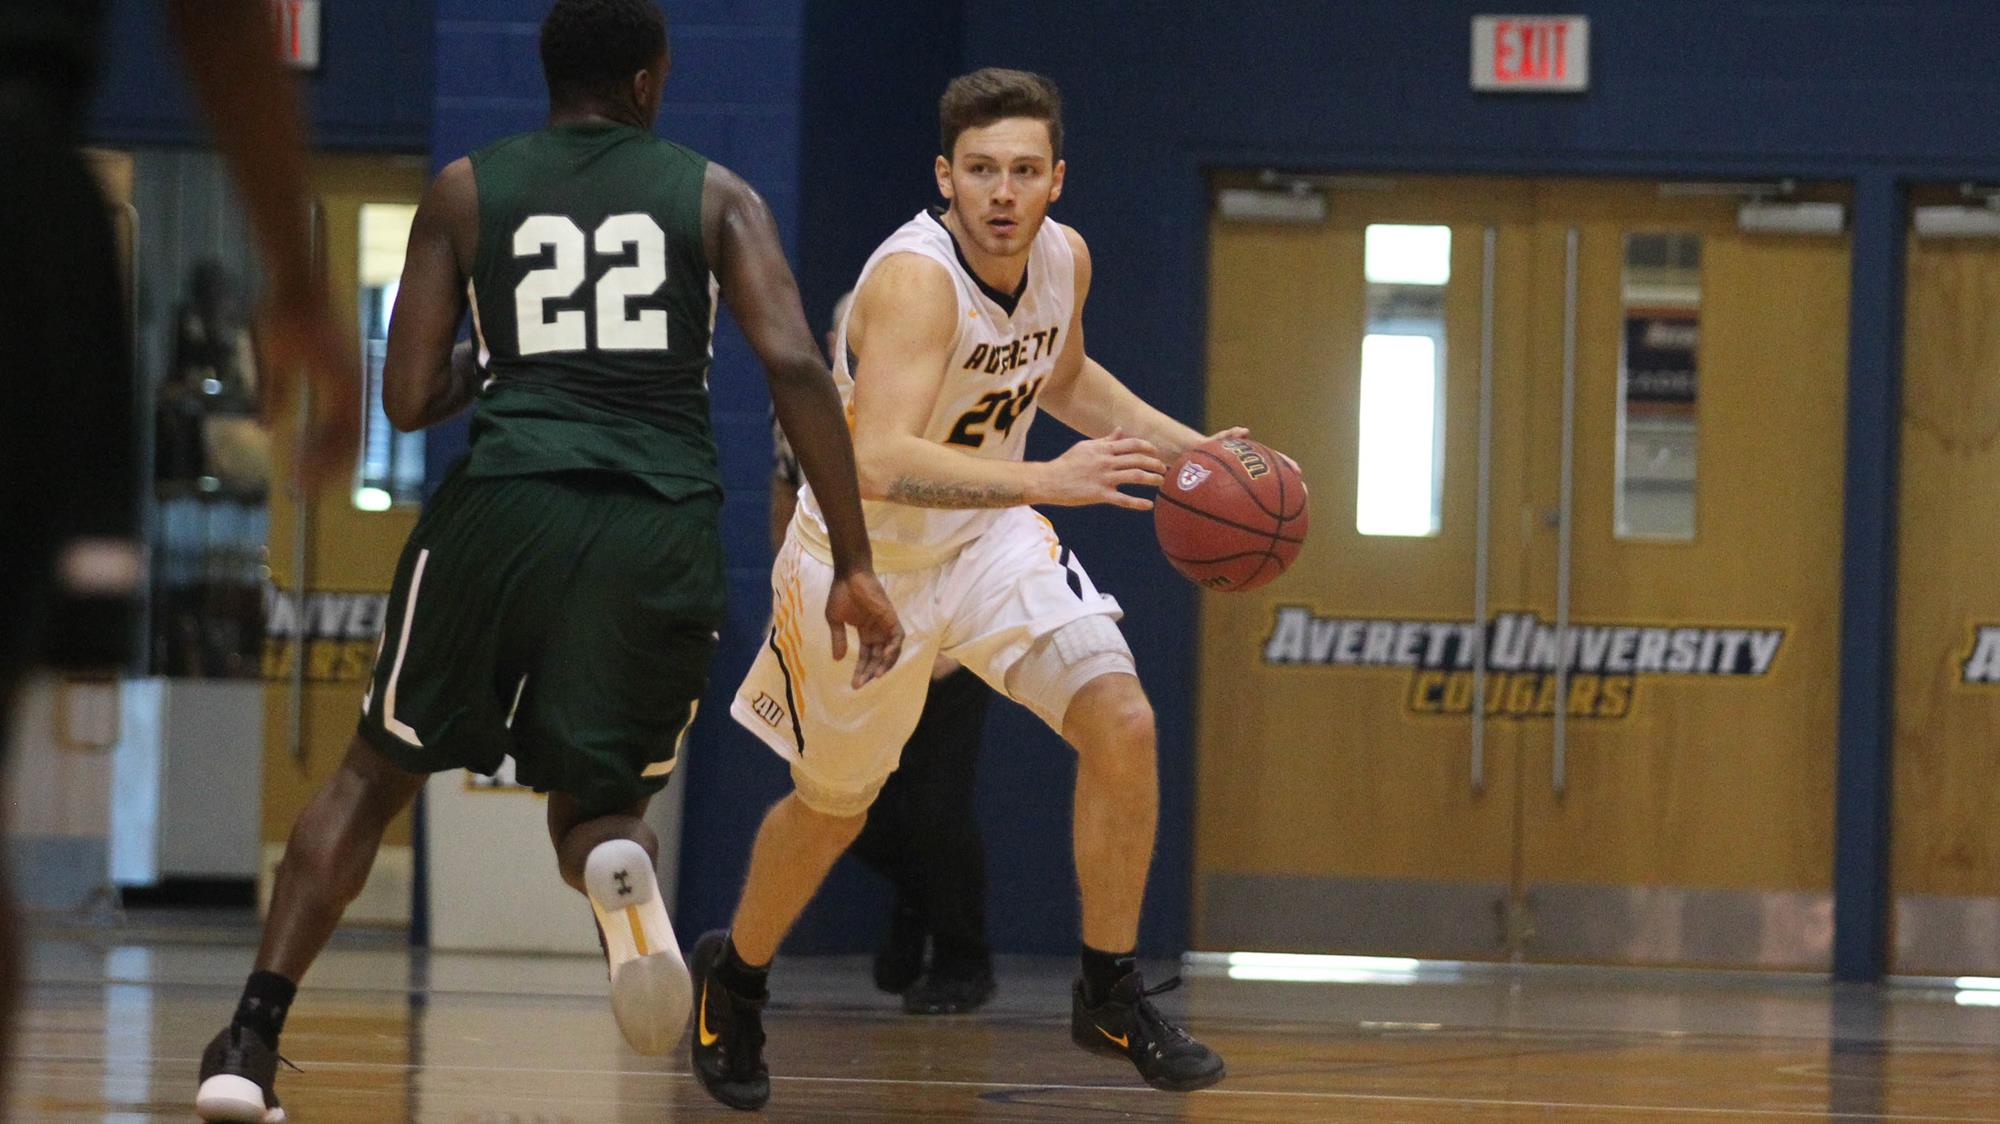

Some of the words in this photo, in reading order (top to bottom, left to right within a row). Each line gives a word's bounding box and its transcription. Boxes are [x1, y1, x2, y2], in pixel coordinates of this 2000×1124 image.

[1494, 21, 1568, 81] EXIT
[513, 213, 669, 357] 22
[944, 376, 1044, 448] 24
[1262, 606, 1485, 668] AVERETT
[1489, 612, 1784, 676] UNIVERSITY
[1412, 666, 1632, 716] COUGARS
